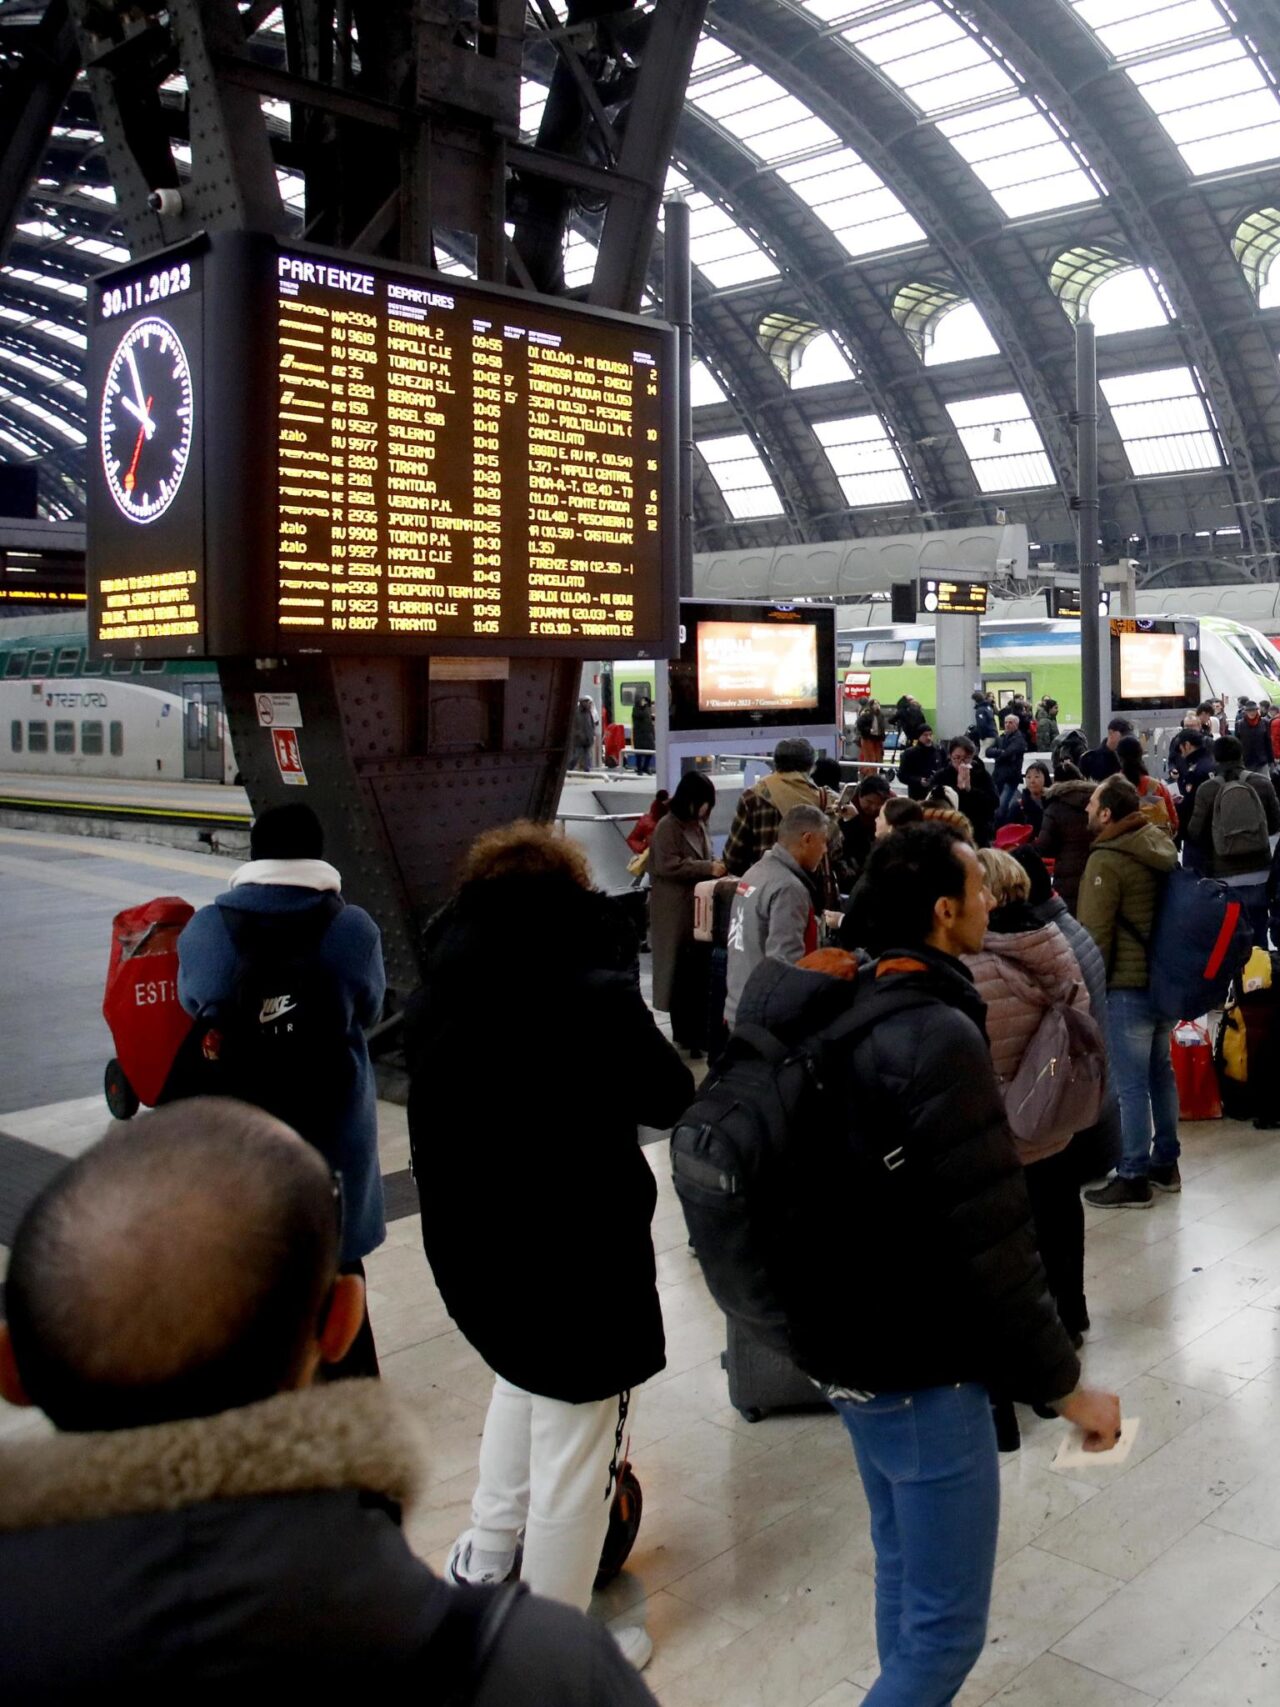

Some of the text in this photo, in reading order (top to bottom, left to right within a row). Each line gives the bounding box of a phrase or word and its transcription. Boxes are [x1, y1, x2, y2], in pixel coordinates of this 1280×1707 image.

[102, 263, 190, 317] 30.11.2023
[278, 257, 374, 295] PARTENZE
[388, 284, 454, 309] DEPARTURES
[331, 326, 346, 341] AV
[347, 329, 375, 345] 9619
[387, 336, 426, 355] NAPOLI
[472, 352, 502, 368] 09:58
[573, 370, 595, 384] 1000
[646, 383, 656, 395] 14
[347, 311, 377, 328] 2934
[435, 327, 443, 340] 2
[472, 334, 502, 351] 09:55
[649, 368, 657, 380] 2
[330, 345, 346, 359] AV
[347, 347, 377, 364] 9508
[387, 354, 427, 372] TORINO
[472, 369, 500, 384] 10:02
[528, 378, 562, 395] TORINO
[347, 365, 363, 379] 35
[387, 372, 433, 390] VENEZIA
[472, 386, 500, 401] 10:05
[347, 382, 375, 399] 2221
[387, 388, 436, 408] BERGAMO
[472, 402, 500, 417] 10:05
[646, 428, 657, 441] 10
[348, 400, 368, 415] 158
[387, 406, 422, 423] BASEL
[423, 411, 445, 426] SBB
[472, 418, 498, 433] 10:10
[528, 426, 584, 445] CANCELLATO
[331, 417, 346, 431] AV
[347, 419, 377, 434] 9527
[387, 424, 435, 442] SALERNO
[473, 436, 498, 450] 10:10
[331, 435, 346, 449] AV
[347, 437, 378, 452] 9977
[387, 442, 435, 459] SALERNO
[473, 452, 498, 467] 10:15
[560, 463, 593, 478] NAPOLI
[347, 454, 378, 470] 2820
[388, 458, 428, 476] TIRANO
[472, 469, 500, 484] 10:20
[650, 489, 657, 501] 6
[347, 472, 372, 487] 2161
[387, 476, 436, 493] MANTOVA
[472, 485, 500, 499] 10:20
[568, 495, 597, 509] PONTE
[644, 503, 657, 515] 23
[347, 490, 375, 505] 2621
[387, 494, 429, 510] VERONA
[473, 502, 500, 516] 10:25
[647, 519, 657, 531] 12
[347, 508, 377, 523] 2936
[471, 519, 500, 533] 10:25
[331, 526, 346, 539] AV
[347, 526, 377, 541] 9908
[388, 529, 428, 545] TORINO
[472, 536, 500, 550] 10:30
[331, 544, 346, 557] AV
[347, 544, 377, 558] 9927
[387, 547, 426, 561] NAPOLI
[472, 553, 500, 566] 10:40
[347, 580, 378, 594] 2938
[471, 586, 500, 599] 10:55
[348, 562, 382, 576] 25514
[387, 564, 435, 579] LOCARNO
[472, 570, 500, 583] 10:43
[528, 573, 584, 587] CANCELLATO
[331, 599, 346, 611] AV
[348, 599, 378, 612] 9623
[472, 603, 500, 616] 10:58
[331, 617, 346, 629] AV
[348, 616, 378, 629] 8807
[388, 617, 436, 631] TARANTO
[472, 620, 498, 632] 11:05
[261, 1023, 294, 1035] IR
